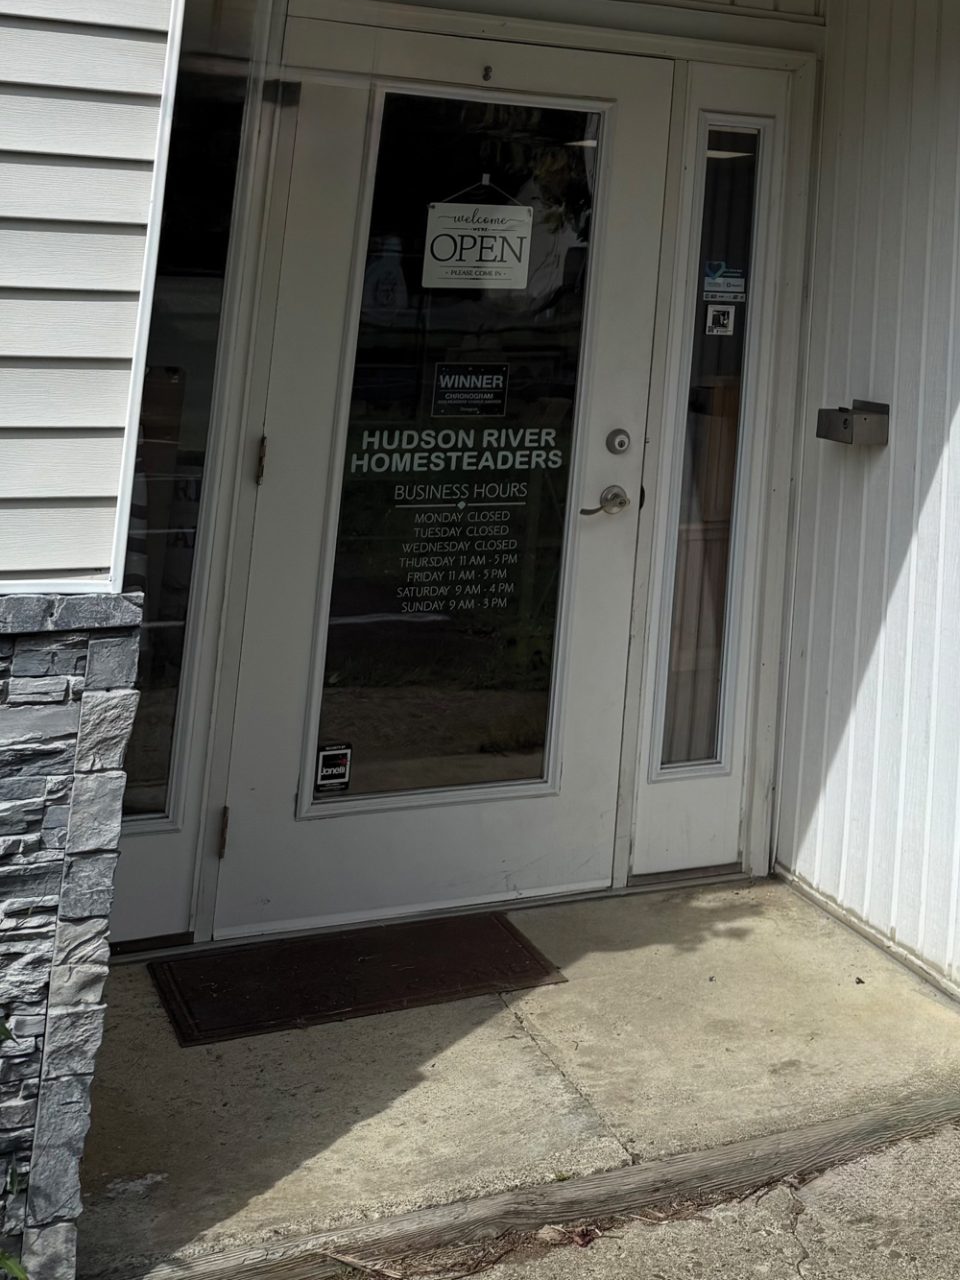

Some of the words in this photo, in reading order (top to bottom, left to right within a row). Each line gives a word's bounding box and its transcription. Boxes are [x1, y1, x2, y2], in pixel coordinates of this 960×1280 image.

[450, 207, 510, 225] welcome
[430, 233, 527, 263] OPEN
[439, 374, 504, 389] WINNER
[361, 429, 475, 450] HUDSON
[482, 428, 557, 448] RIVER
[350, 450, 563, 473] HOMESTEADERS
[394, 483, 470, 500] BUSINESS
[473, 482, 528, 498] HOURS
[414, 512, 465, 524] MONDAY
[467, 510, 511, 523] CLOSED
[413, 526, 463, 538] TUESDAY
[466, 525, 509, 537] CLOSED
[402, 541, 471, 553] WEDNESDAY
[474, 539, 518, 551] CLOSED
[399, 556, 456, 568] THURSDAY
[459, 555, 467, 566] 11
[469, 555, 486, 565] AM
[494, 554, 500, 565] 5
[501, 554, 518, 564] PM
[407, 570, 445, 583] FRIDAY
[448, 570, 456, 581] 11
[458, 569, 475, 580] AM
[483, 569, 489, 579] 5
[490, 568, 507, 579] PM
[396, 585, 452, 598] SATURDAY
[455, 584, 462, 595] 9
[464, 584, 481, 595] AM
[489, 583, 496, 593] 4
[498, 583, 514, 593] PM
[401, 600, 446, 613] SUNDAY
[449, 599, 456, 610] 9
[457, 599, 475, 609] AM
[483, 598, 489, 608] 3
[490, 597, 507, 608] PM
